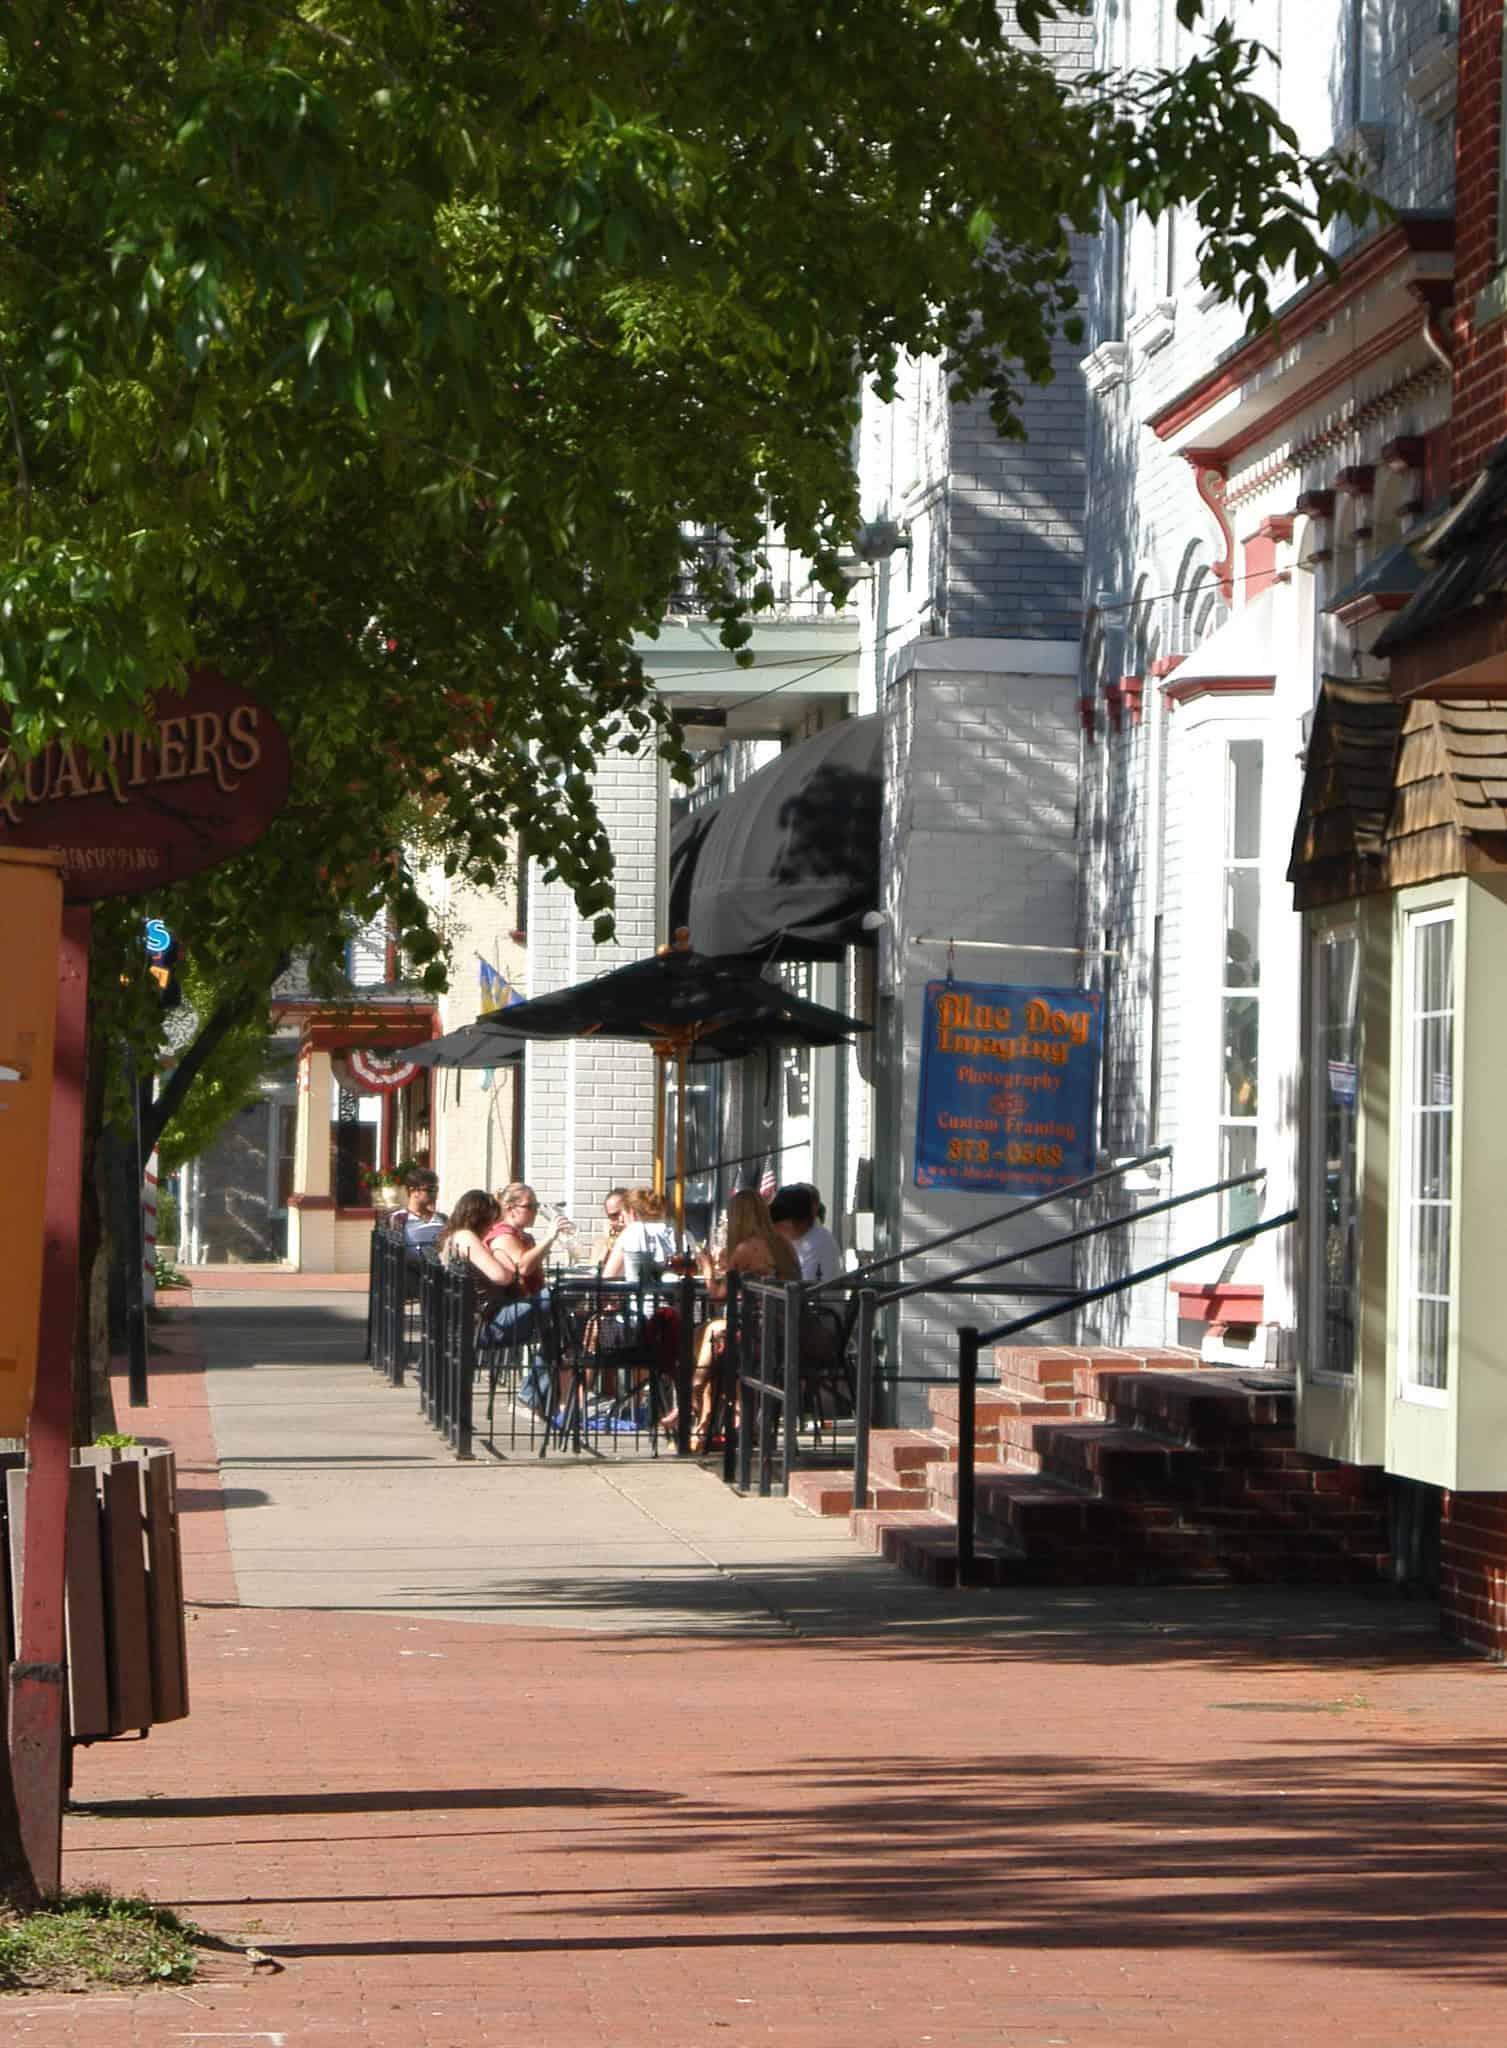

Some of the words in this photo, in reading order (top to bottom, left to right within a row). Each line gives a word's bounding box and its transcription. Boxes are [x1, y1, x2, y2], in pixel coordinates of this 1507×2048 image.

[937, 994, 1010, 1030] Blue
[1025, 999, 1090, 1044] Dog
[938, 1028, 1068, 1063] Imaging
[957, 1065, 1061, 1092] Photography
[938, 1112, 998, 1132] Custom
[1005, 1117, 1075, 1142] Framing
